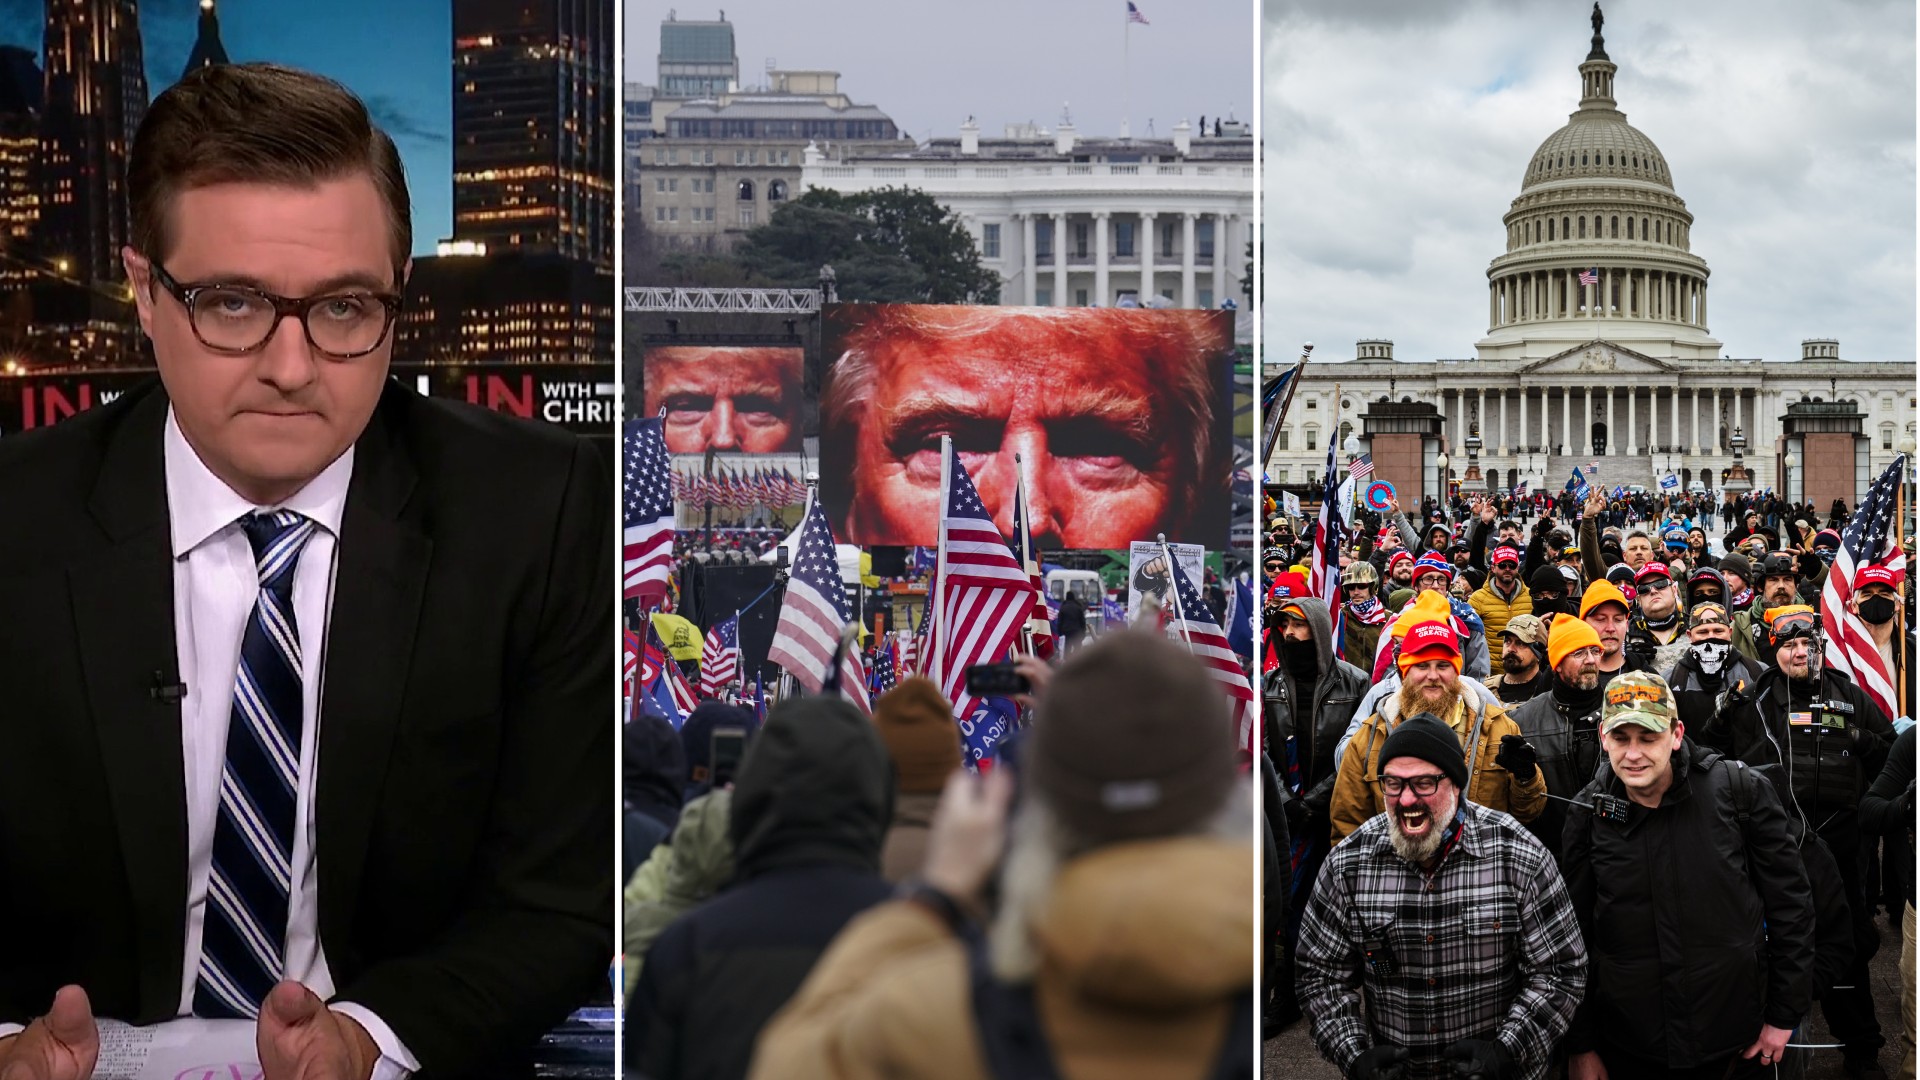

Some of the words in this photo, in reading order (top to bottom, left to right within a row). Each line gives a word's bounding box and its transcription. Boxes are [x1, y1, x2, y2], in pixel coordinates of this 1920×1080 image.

[22, 383, 91, 431] IN
[467, 374, 533, 420] IN
[542, 381, 592, 399] WITH
